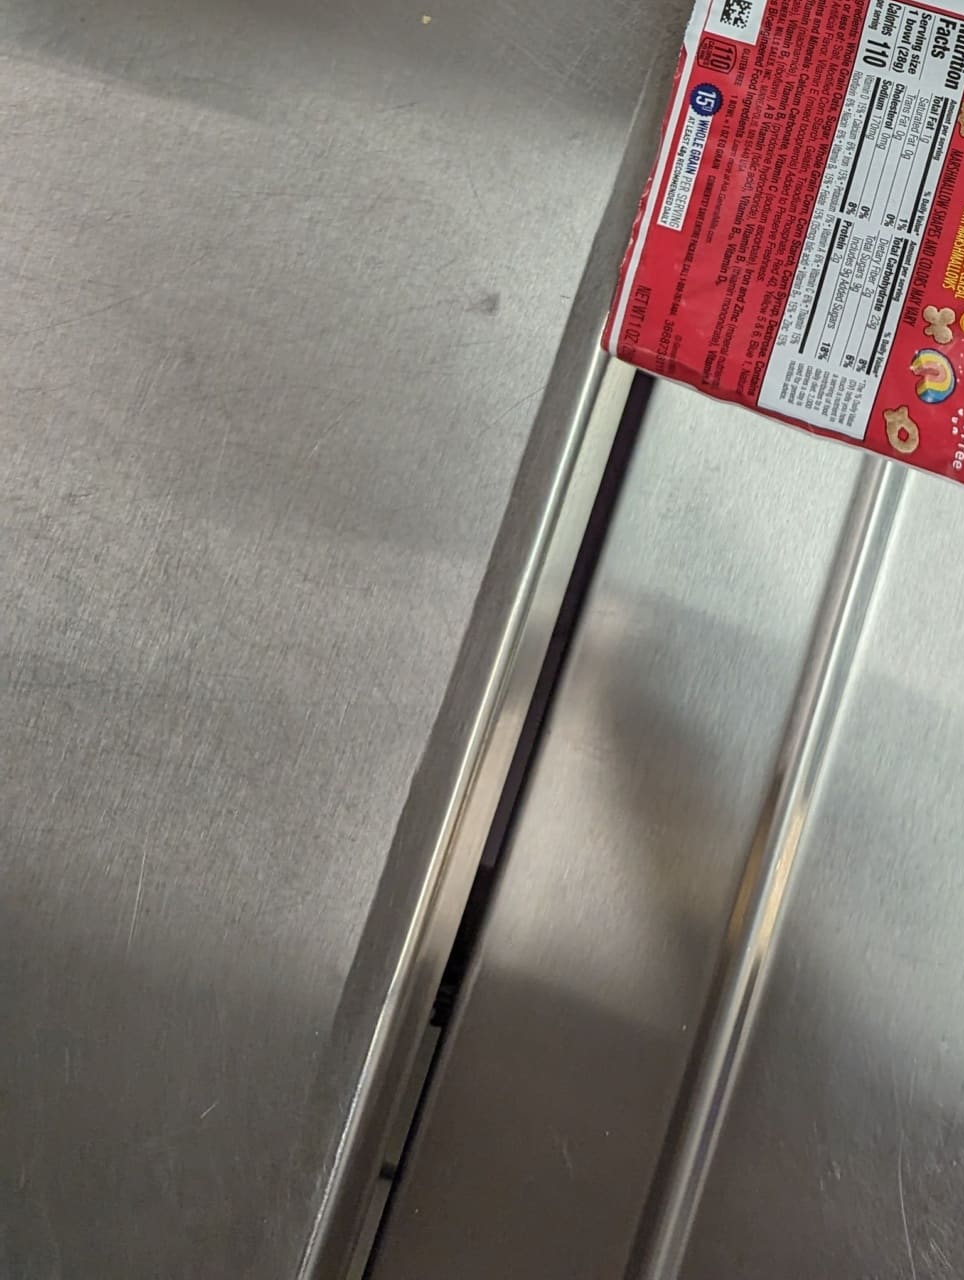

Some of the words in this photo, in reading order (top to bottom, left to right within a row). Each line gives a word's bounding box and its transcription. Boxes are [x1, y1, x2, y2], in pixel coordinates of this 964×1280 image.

[868, 9, 882, 30] serving
[880, 2, 901, 37] Calories
[907, 8, 919, 16] 1
[901, 18, 916, 44] bowl
[911, 12, 932, 52] Serving
[929, 17, 957, 60] Facts
[709, 44, 734, 70] 110
[737, 48, 750, 71] GLUTEN
[841, 42, 855, 66] Whole
[861, 38, 891, 68] 110
[891, 45, 910, 73] (28g)
[907, 54, 921, 75] size
[733, 71, 745, 86] FREE
[835, 67, 849, 90] Grain
[826, 91, 842, 114] Oats,
[875, 79, 891, 111] Sodium
[902, 93, 915, 113] Trans
[929, 95, 943, 115] Total
[724, 100, 737, 118] BOWL
[884, 83, 904, 129] Cholesterol
[910, 96, 928, 133] Saturated
[943, 99, 957, 124] Amount
[686, 115, 695, 125] AT
[819, 114, 835, 142] Sugar,
[865, 114, 881, 140] 170mg
[897, 114, 910, 128] Fat
[925, 116, 937, 130] Fat
[939, 124, 950, 137] per
[681, 125, 694, 144] LEAST
[692, 119, 708, 148] WHOLE
[719, 128, 729, 139] OZ
[875, 131, 890, 150] 0mg
[891, 128, 905, 142] 0g
[906, 133, 919, 147] Fat
[918, 132, 931, 144] 1g
[710, 148, 724, 169] GRAIN
[813, 143, 828, 169] Whole
[900, 147, 913, 161] 0g
[933, 137, 946, 160] serving
[685, 148, 701, 174] GRAIN
[665, 158, 684, 205] RECOMMENDED
[678, 175, 692, 191] PER
[806, 170, 820, 192] Grain
[938, 148, 963, 208] MARSHMALLOW
[658, 206, 671, 224] DAILY
[669, 193, 687, 228] SERVING
[799, 193, 813, 216] Corn,
[844, 201, 858, 215] 8%
[857, 205, 870, 219] 0%
[916, 198, 929, 214] Daily
[793, 217, 807, 238] Corn
[882, 213, 896, 227] 0%
[895, 217, 909, 231] 1%
[927, 209, 946, 238] SHAPES
[836, 220, 851, 249] Protein
[861, 234, 875, 252] Total
[784, 239, 801, 268] Starch,
[844, 236, 861, 267] Includes
[871, 237, 887, 264] Dietary
[889, 236, 902, 256] Total
[903, 240, 917, 265] Amount
[921, 239, 936, 257] AND
[829, 251, 842, 264] 2g
[852, 252, 869, 279] Sugars
[778, 269, 792, 290] Corn
[838, 266, 852, 279] 9g
[867, 265, 880, 285] Fiber
[898, 265, 910, 278] per
[913, 257, 931, 287] COLORS
[634, 284, 650, 304] NET
[834, 278, 848, 302] Added
[848, 280, 861, 293] 9g
[860, 285, 874, 299] 2g
[872, 257, 896, 312] Carbohydrate
[892, 278, 906, 302] serving
[769, 290, 785, 318] Syrup,
[908, 288, 923, 305] MAY
[630, 304, 645, 320] WT
[824, 302, 841, 329] Sugars
[866, 313, 880, 330] 23g
[902, 305, 918, 326] VARY
[624, 328, 639, 343] OZ
[817, 341, 830, 360] 18%
[876, 338, 890, 355] Daily
[841, 354, 855, 368] 6%
[854, 358, 867, 373] 8%
[747, 360, 765, 397] Contains
